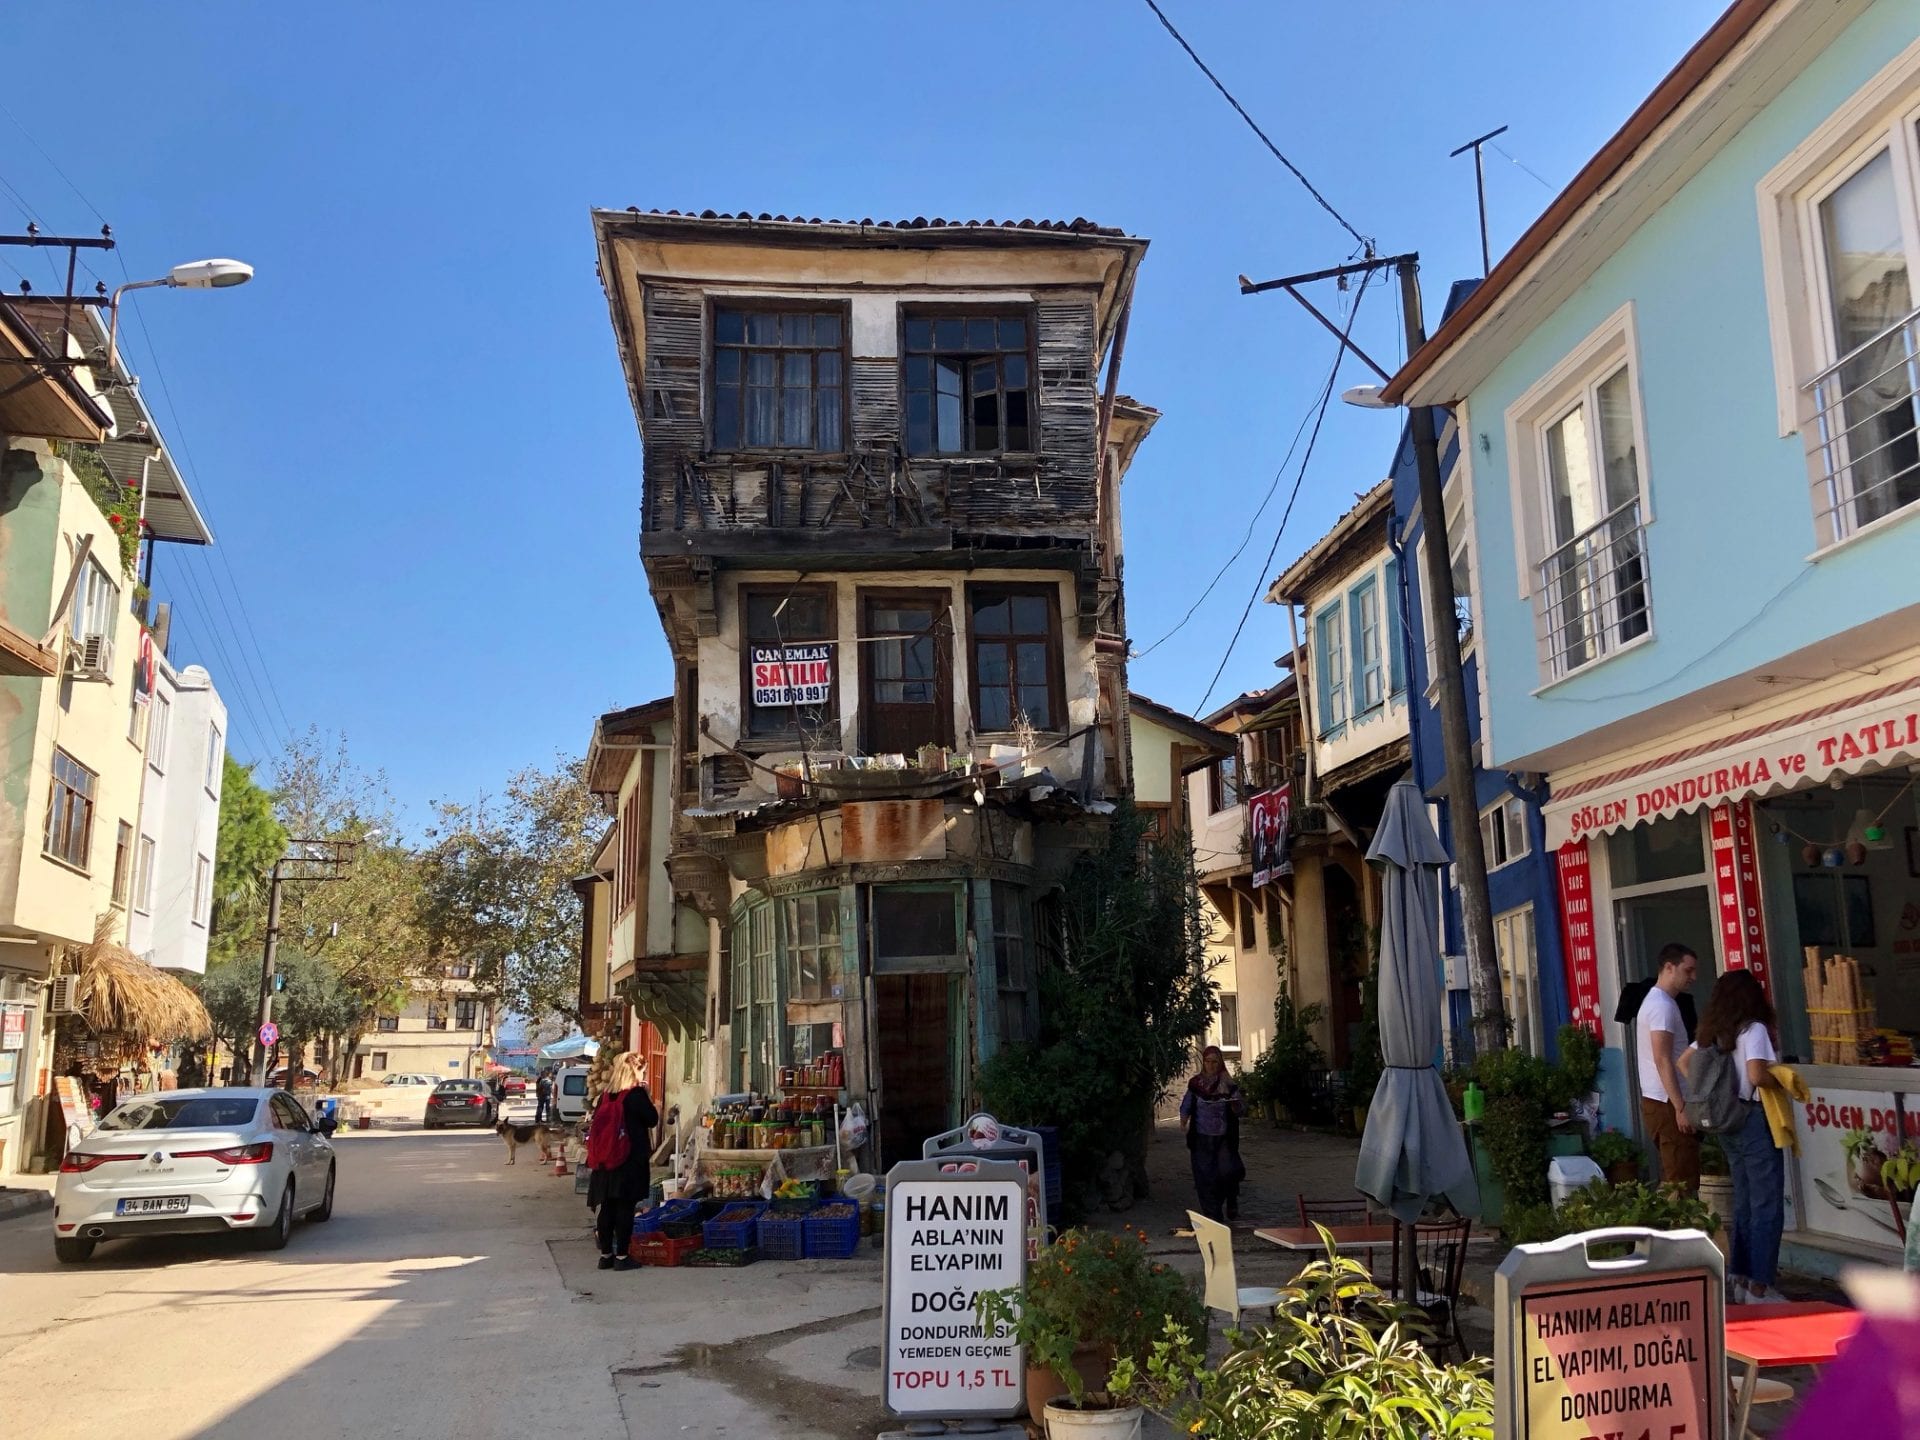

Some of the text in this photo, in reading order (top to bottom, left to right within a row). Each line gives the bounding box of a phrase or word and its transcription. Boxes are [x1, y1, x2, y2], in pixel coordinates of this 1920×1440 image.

[756, 647, 829, 661] CAN EMLAK
[756, 663, 829, 687] SATILIK
[757, 689, 781, 703] 0531
[806, 686, 819, 700] 99
[1571, 714, 1919, 837] ŞÖLEN DONDURMA ve TATLI
[1560, 850, 1587, 868] TULUMBA
[1568, 875, 1583, 891] SADE
[1568, 898, 1587, 914] KAKAO
[1806, 1097, 1864, 1132] ŞÖLEN
[126, 1199, 186, 1211] 34 BAN 854
[906, 1195, 1008, 1221] HANIM
[911, 1229, 1003, 1246] ABLA'NIN
[911, 1254, 1002, 1271] ELYAPIMI
[1537, 1298, 1691, 1339] HANIM ABLA'nın
[899, 1346, 1011, 1359] YEMEDEN GEÇME
[1534, 1334, 1698, 1383] EL YAPIMI, DOĞAL
[893, 1369, 1016, 1390] TOPU 1,5 TL
[1561, 1382, 1672, 1422] DONDURMA
